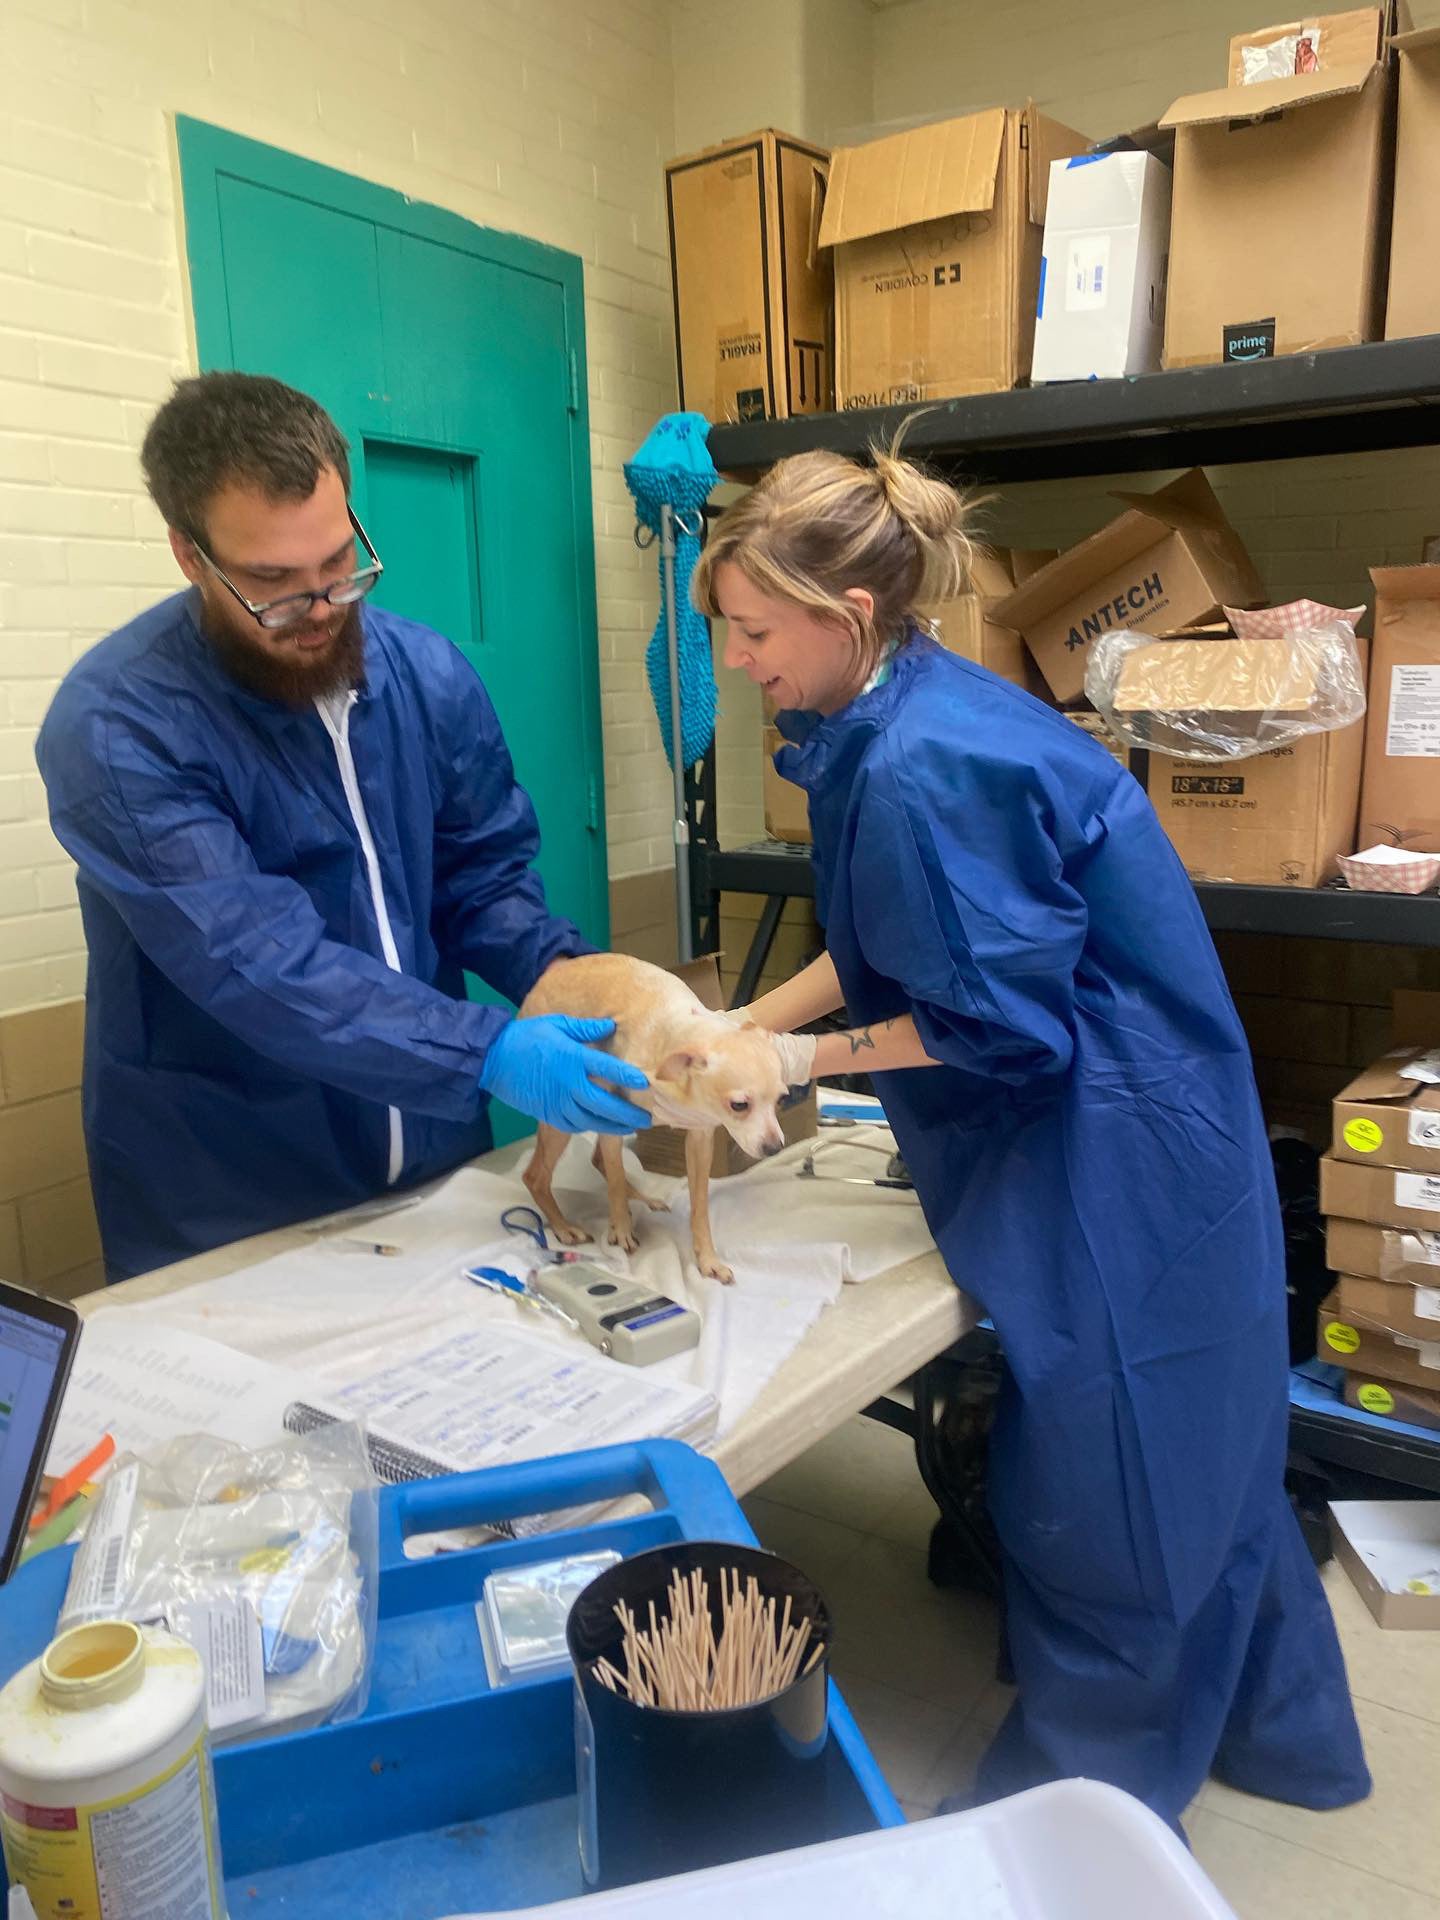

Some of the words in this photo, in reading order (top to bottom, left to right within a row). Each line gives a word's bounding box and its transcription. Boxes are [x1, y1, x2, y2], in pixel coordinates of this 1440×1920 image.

[875, 274, 928, 293] COVIDIEN
[720, 341, 761, 361] FRAGILE
[1229, 336, 1266, 353] prime
[1064, 572, 1163, 653] ANTECH
